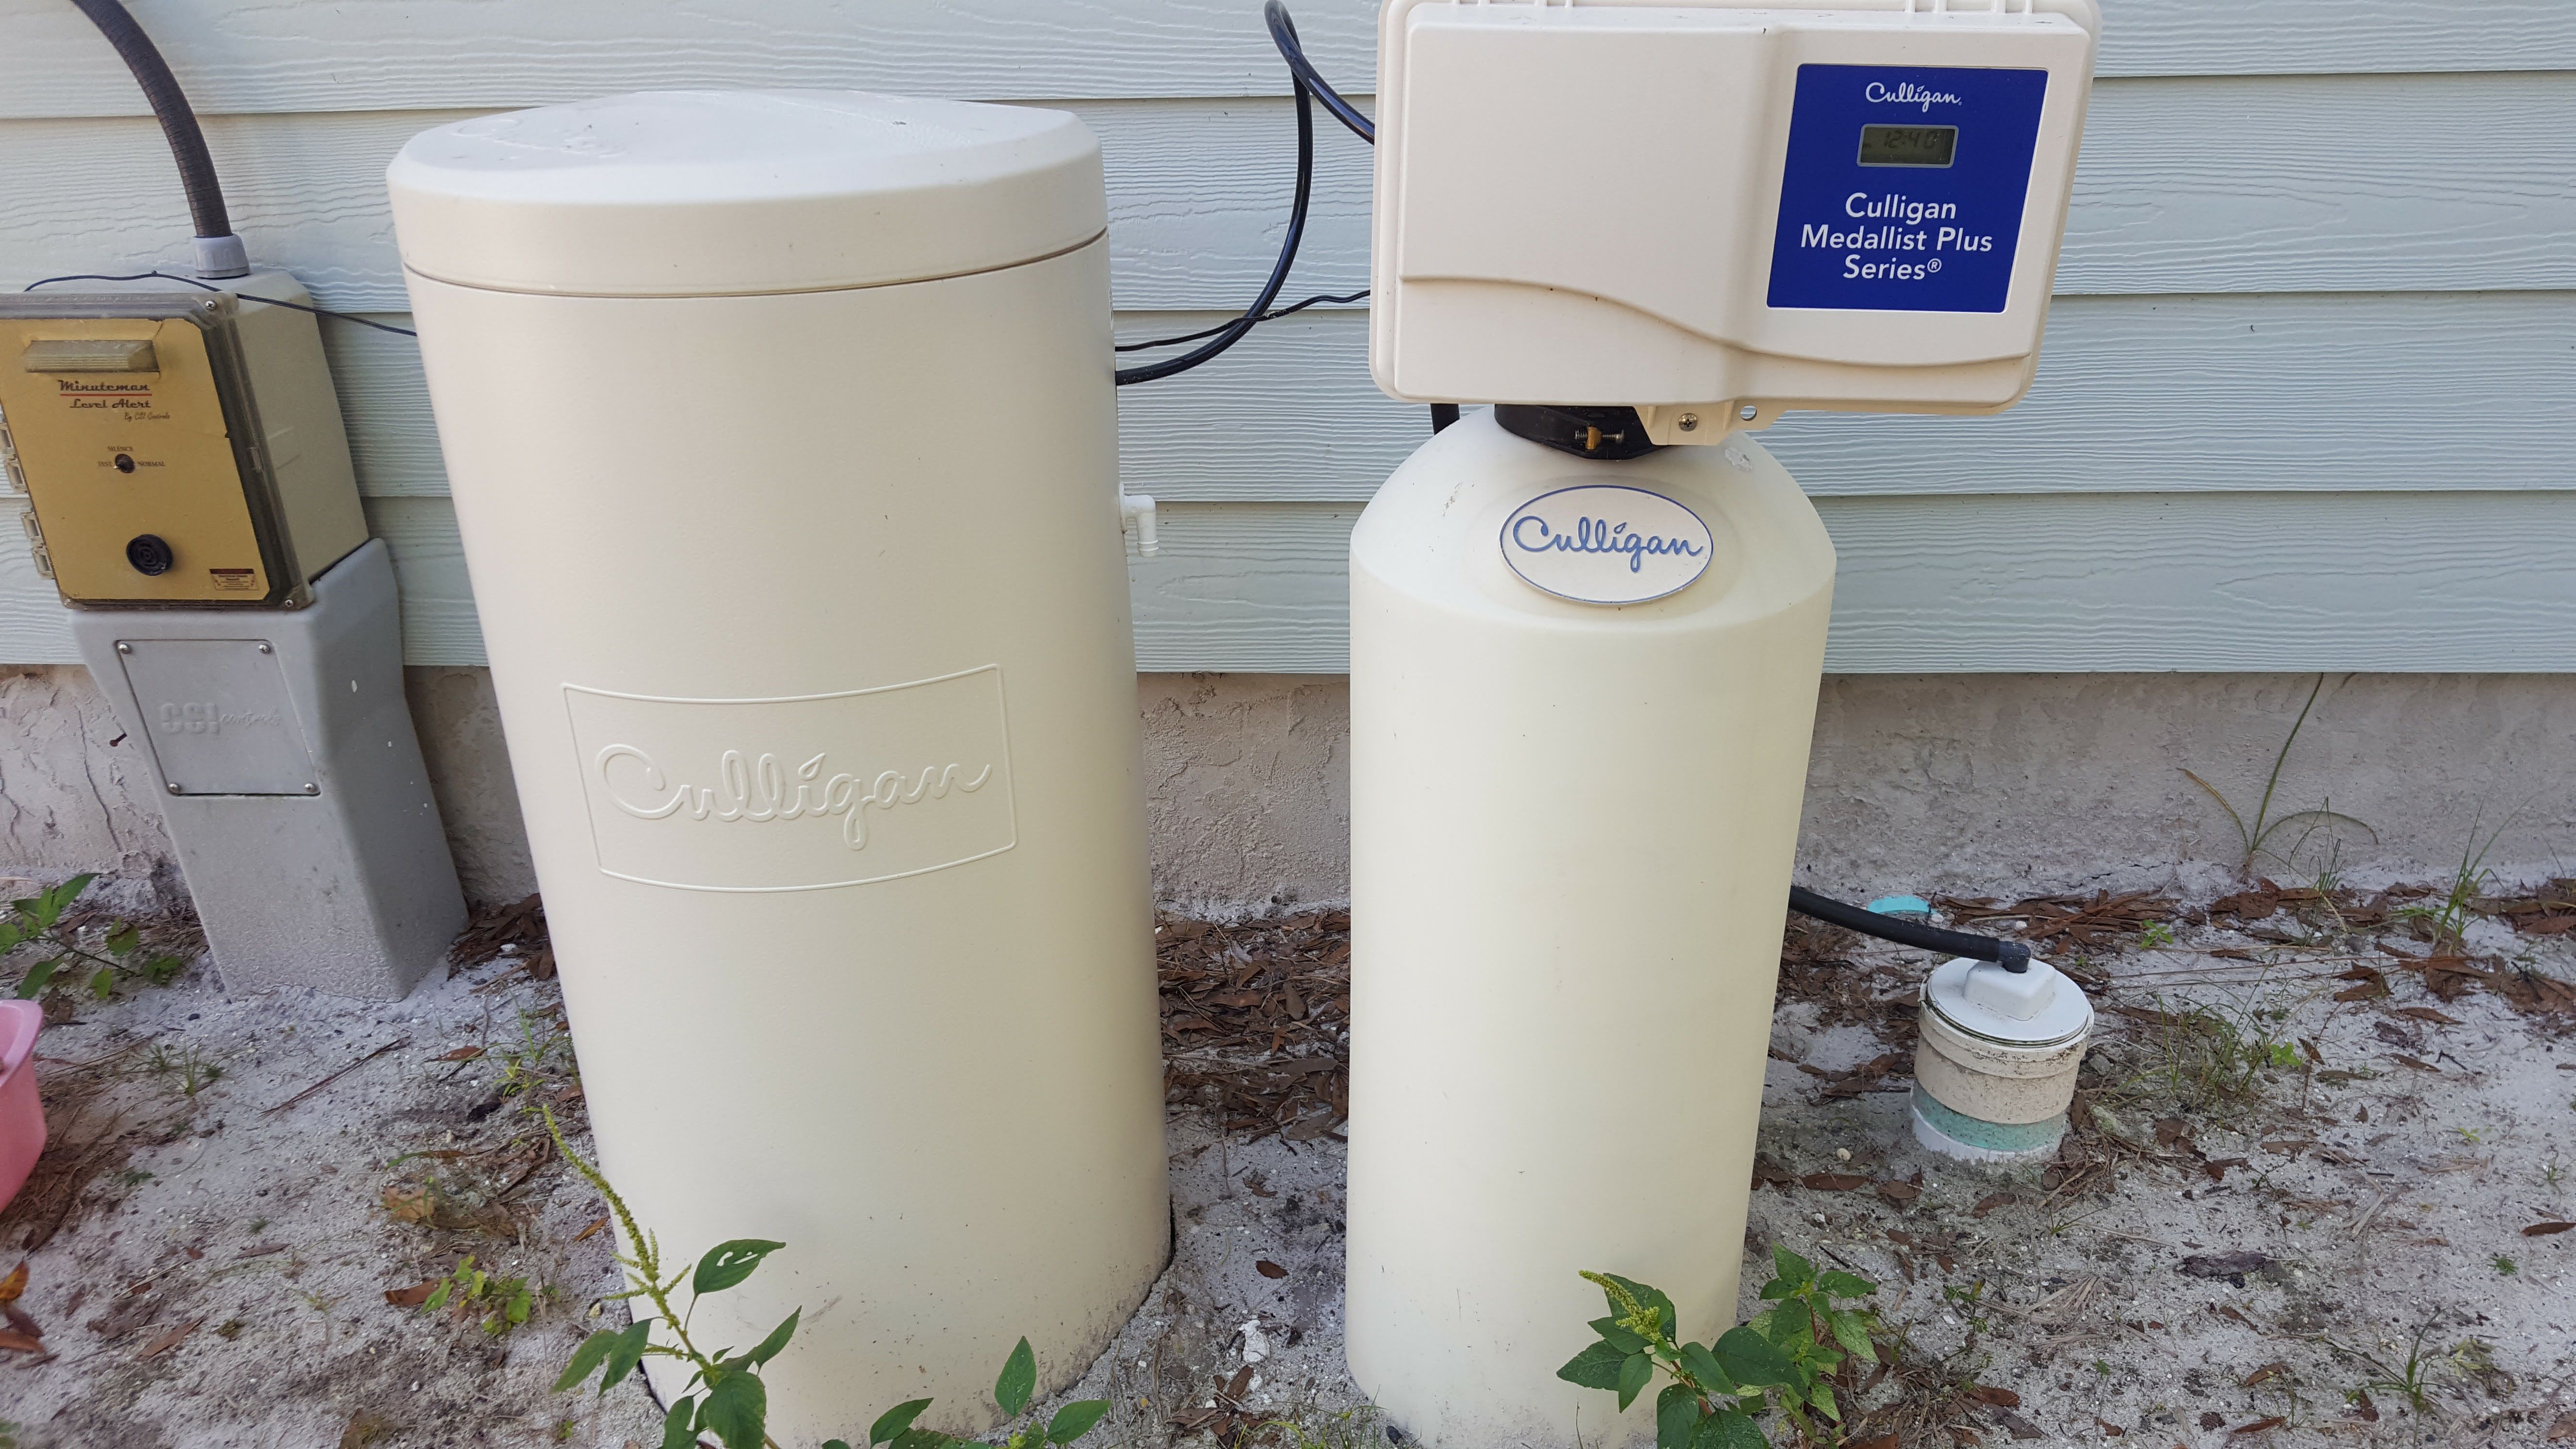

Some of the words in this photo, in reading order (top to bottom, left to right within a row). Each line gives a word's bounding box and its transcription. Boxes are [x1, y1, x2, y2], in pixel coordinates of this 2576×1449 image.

[1866, 81, 1961, 113] Culligan
[1845, 192, 1956, 225] Culligan
[1801, 224, 1927, 251] Medallist
[1936, 227, 1993, 252] Plus
[58, 380, 150, 391] Minuteman
[69, 399, 108, 408] Level
[112, 399, 151, 408] Alert
[1513, 515, 1704, 573] Culligan
[595, 743, 993, 851] Culligan
